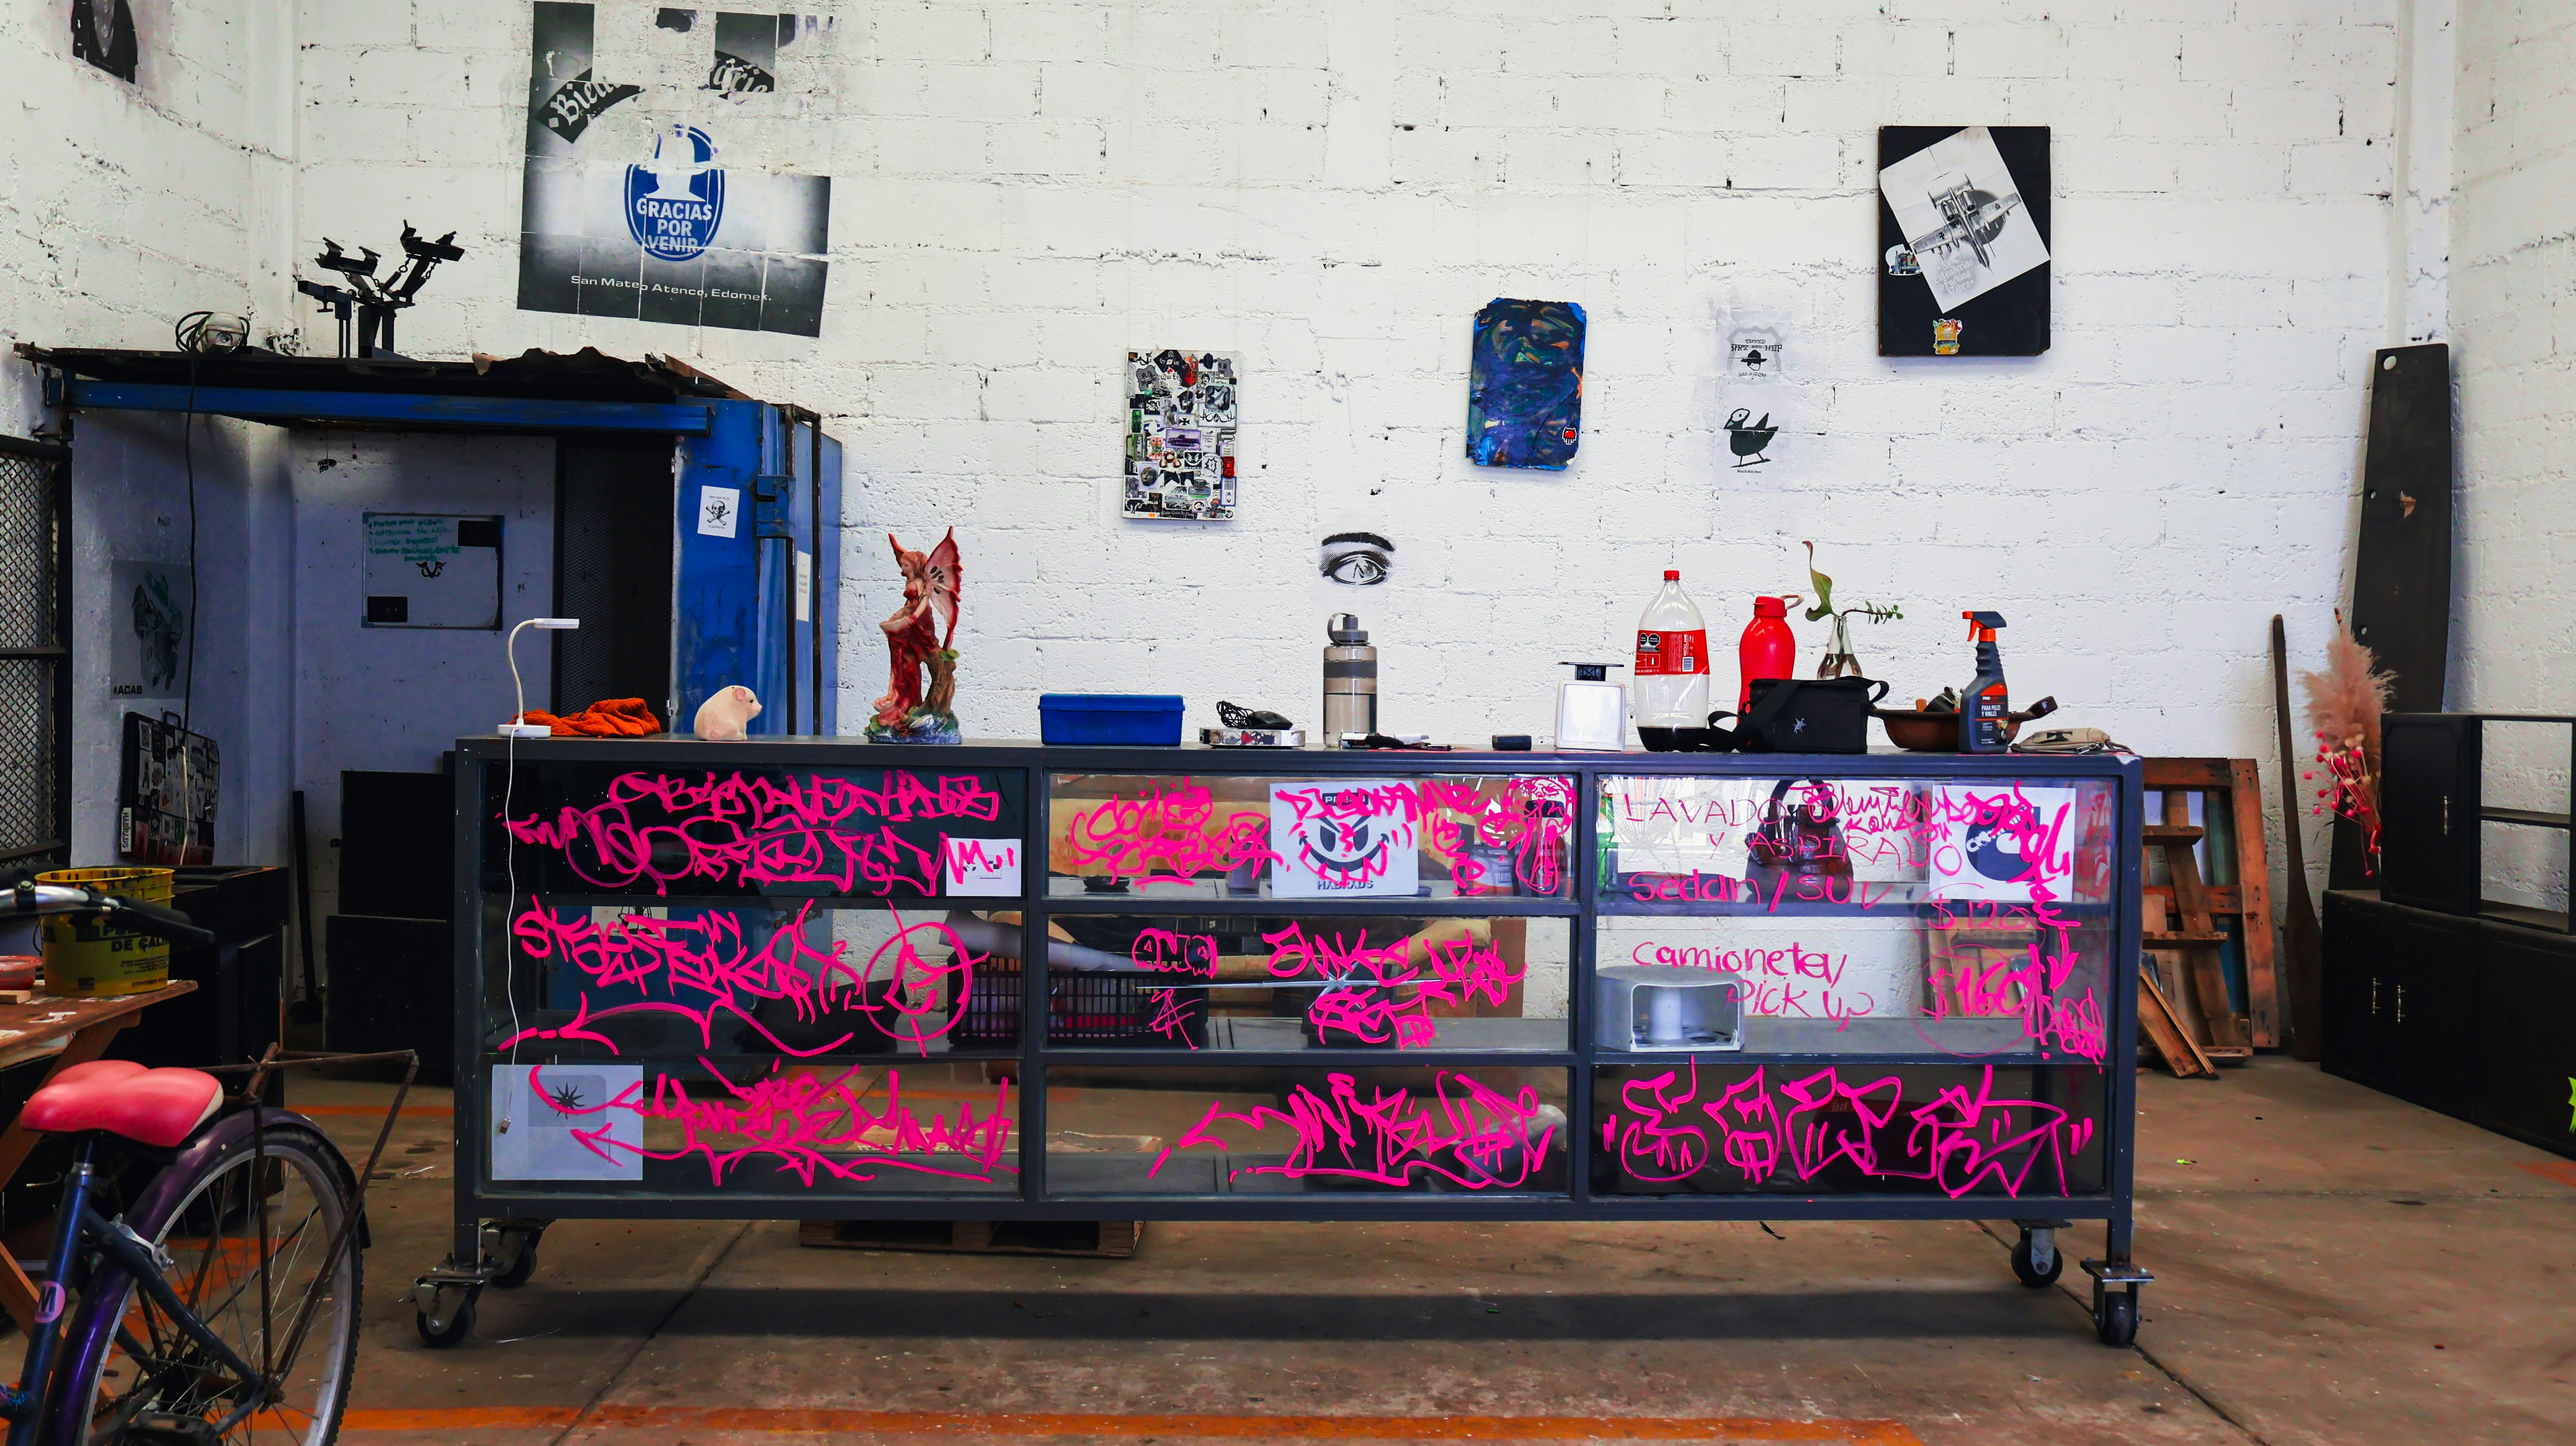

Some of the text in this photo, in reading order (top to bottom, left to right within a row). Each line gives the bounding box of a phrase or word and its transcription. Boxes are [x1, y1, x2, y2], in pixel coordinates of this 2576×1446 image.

[636, 197, 712, 221] GRACIAS
[657, 219, 692, 237] POR
[571, 275, 772, 301] San Mateo Atenco, Edomex.
[113, 685, 143, 695] #ACAB
[1624, 793, 1787, 826] LAVADO
[111, 939, 134, 953] DE
[1918, 961, 2033, 1023] $160
